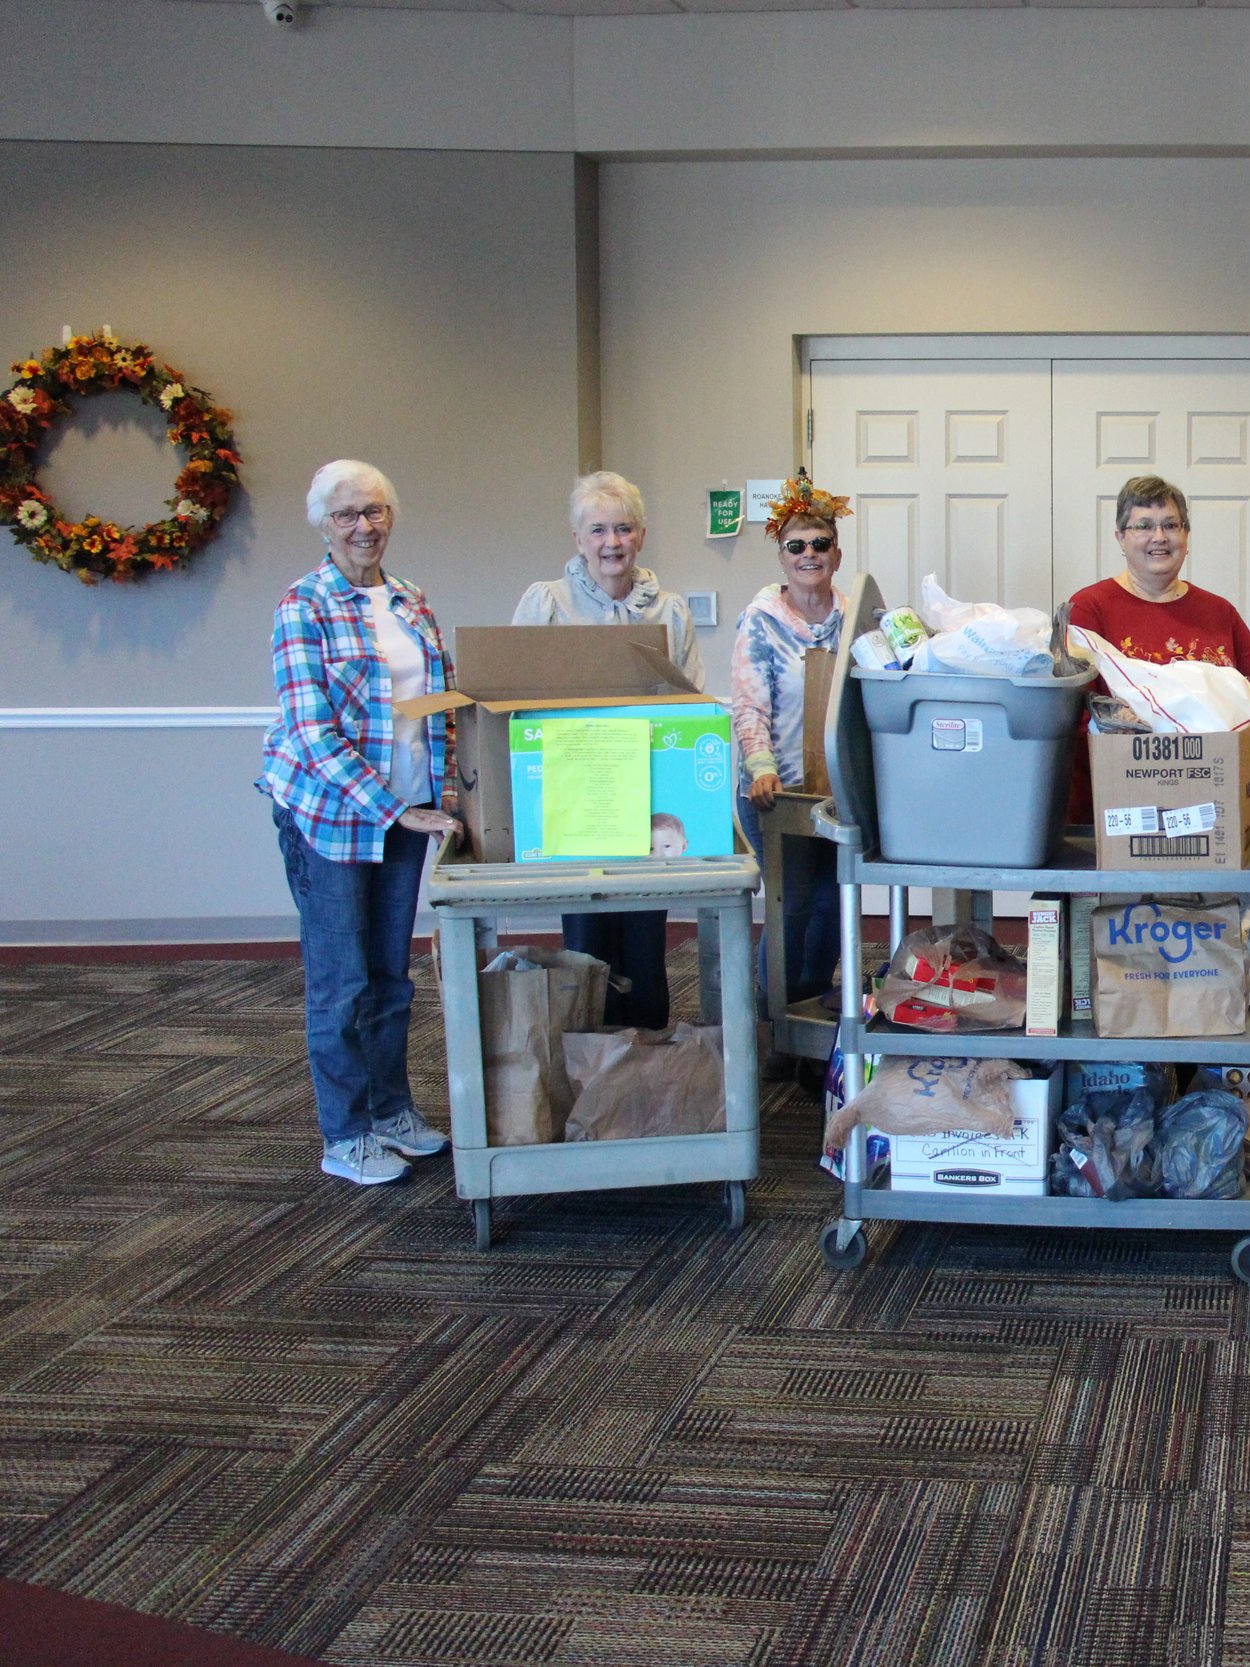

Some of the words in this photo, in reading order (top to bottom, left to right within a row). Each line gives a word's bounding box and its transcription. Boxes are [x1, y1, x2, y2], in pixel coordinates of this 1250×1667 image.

[717, 509, 733, 517] FOR
[1132, 735, 1180, 761] 01381
[1125, 768, 1184, 779] NEWPORT
[1186, 767, 1212, 779] FSC
[1156, 779, 1180, 787] KINGS
[1031, 915, 1057, 924] JACK
[1107, 903, 1227, 964] Kroger
[1124, 971, 1152, 981] FRESH
[1153, 971, 1171, 980] FOR
[1173, 968, 1220, 980] EVERYONE
[1081, 1070, 1130, 1088] Idaho
[981, 1148, 991, 1158] in
[994, 1144, 1026, 1158] Front
[936, 1173, 977, 1183] BANKERS
[978, 1174, 997, 1183] BOX
